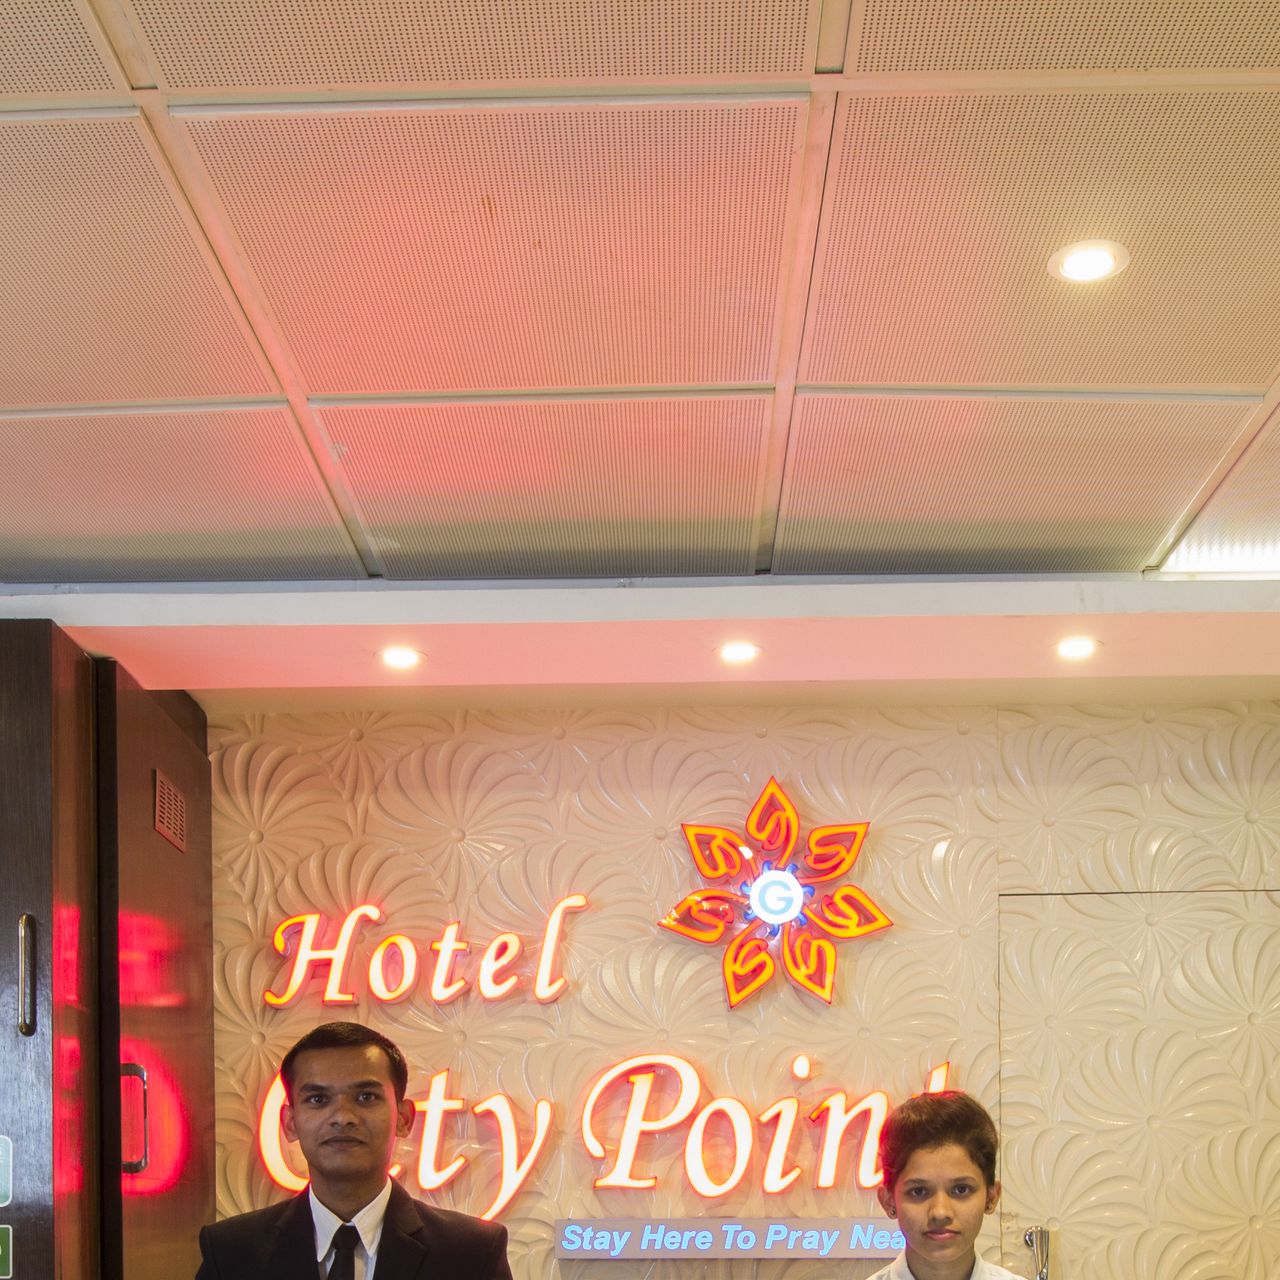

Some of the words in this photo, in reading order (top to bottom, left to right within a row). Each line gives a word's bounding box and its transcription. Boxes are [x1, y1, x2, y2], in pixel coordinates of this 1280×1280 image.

[758, 880, 795, 916] G
[263, 894, 588, 1008] Hotel
[581, 1053, 950, 1198] Poin
[561, 1224, 630, 1256] Stay
[640, 1224, 713, 1251] Here
[721, 1224, 757, 1251] To
[764, 1224, 840, 1256] Pray
[849, 1224, 906, 1251] Nea
